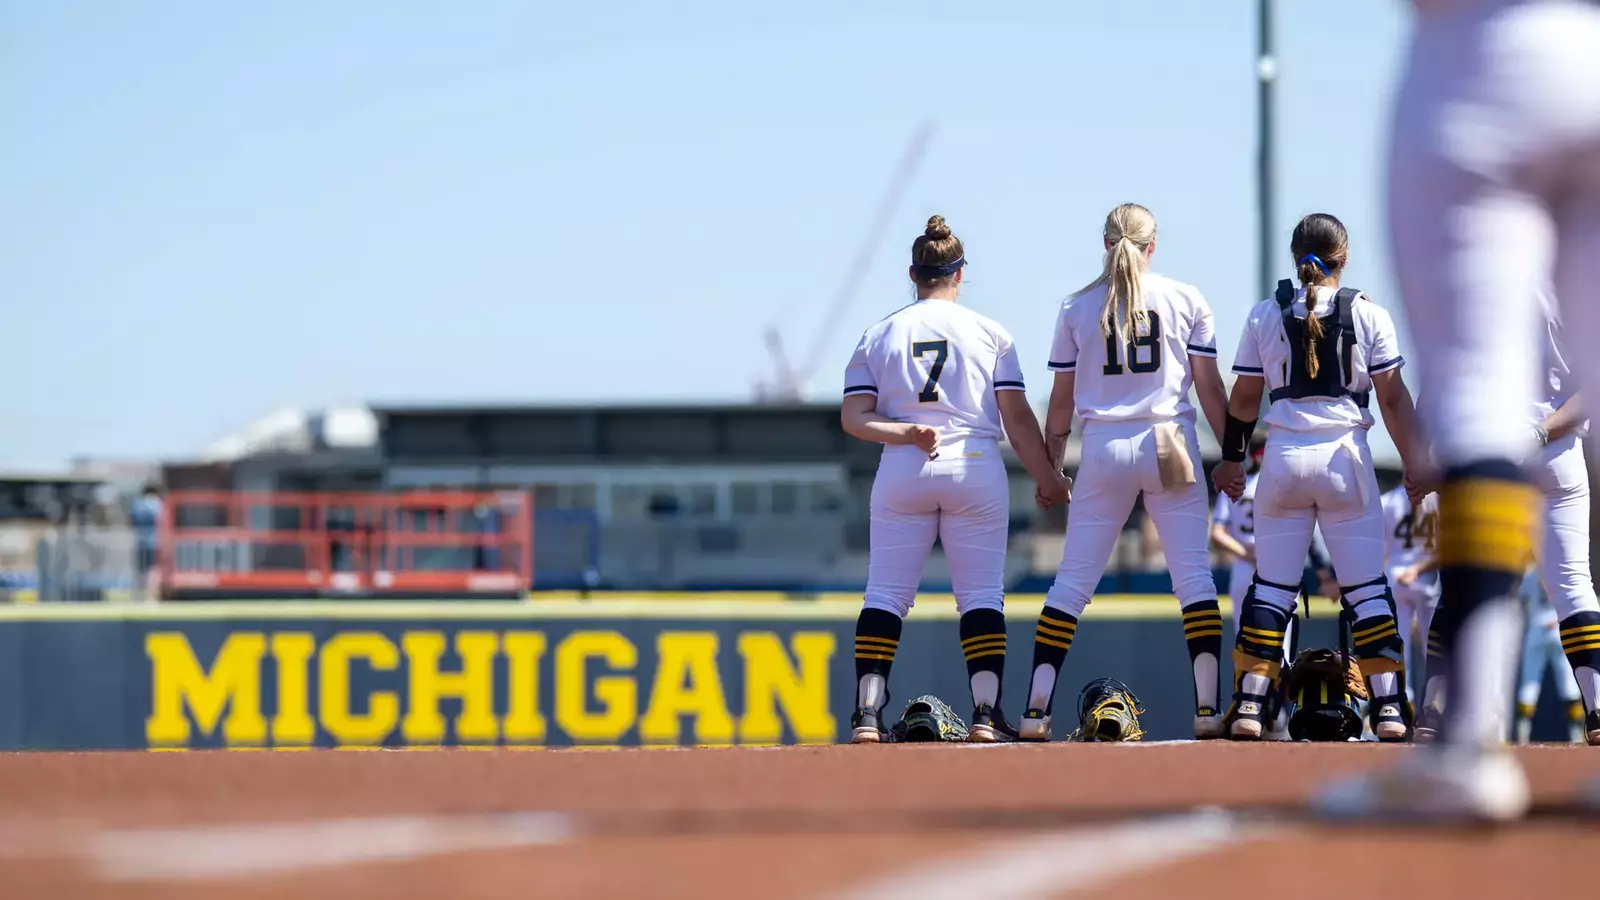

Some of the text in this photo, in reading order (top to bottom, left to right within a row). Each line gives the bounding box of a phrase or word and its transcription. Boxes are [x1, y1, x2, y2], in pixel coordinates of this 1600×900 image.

[912, 339, 948, 402] 7
[1101, 309, 1161, 376] 18
[1394, 512, 1436, 550] 44
[146, 631, 837, 743] MICHIGAN
